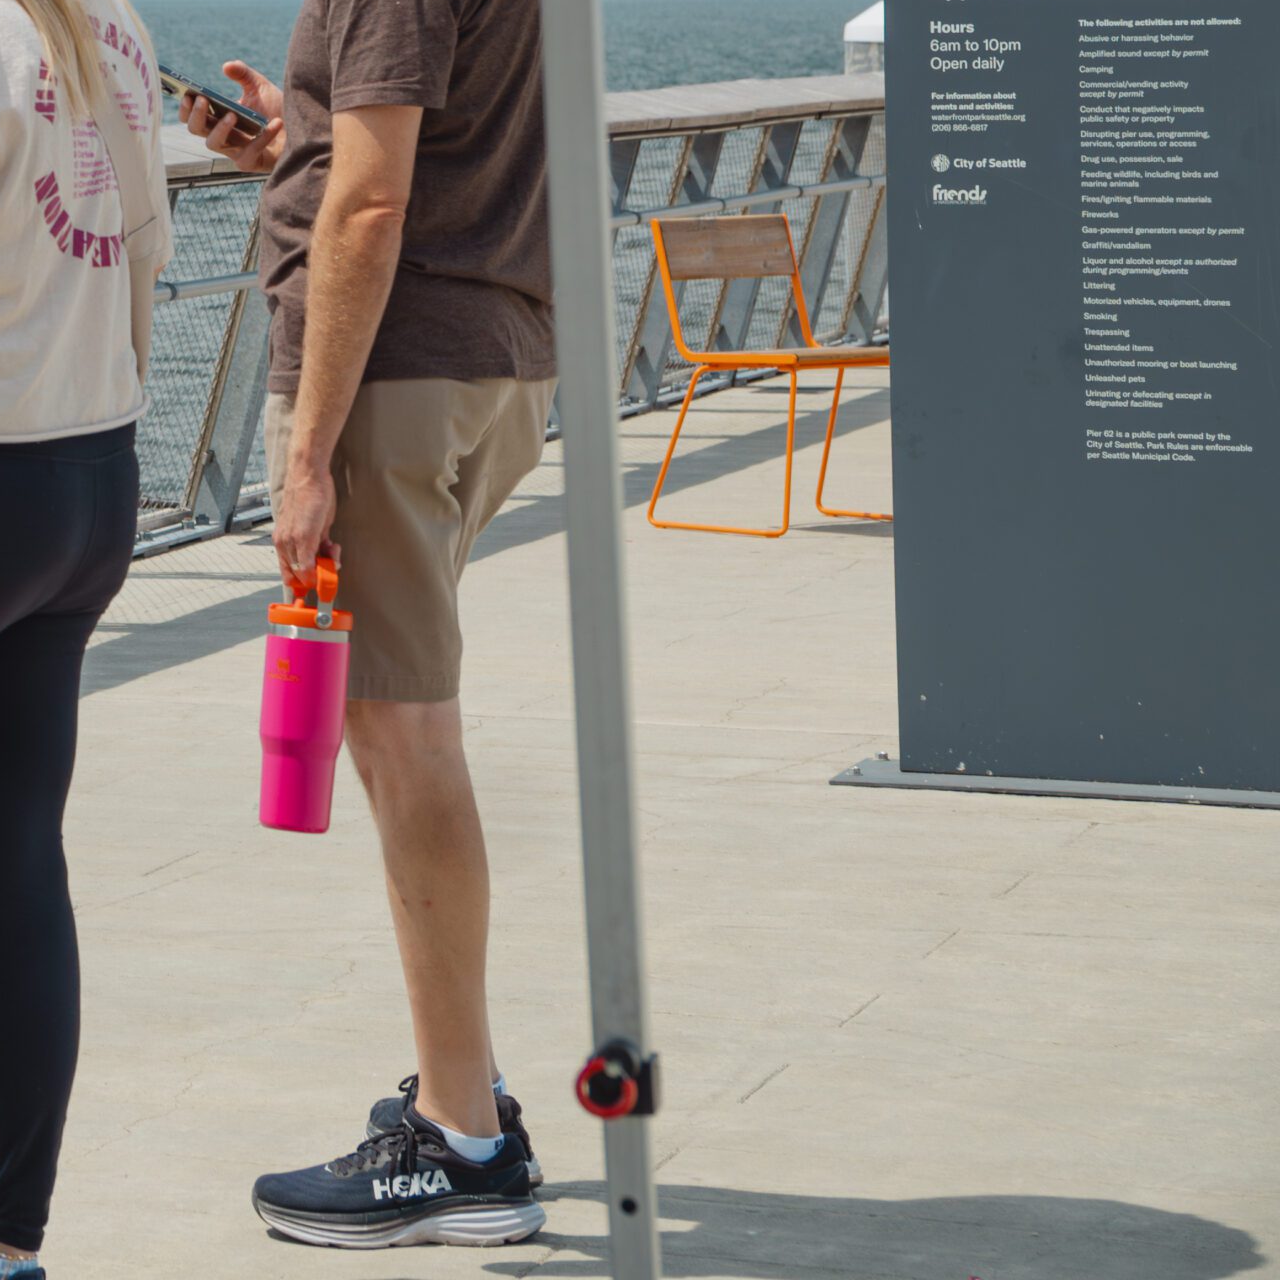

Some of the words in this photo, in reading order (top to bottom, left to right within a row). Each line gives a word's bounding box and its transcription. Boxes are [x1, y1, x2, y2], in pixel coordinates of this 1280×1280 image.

[930, 21, 974, 34] Hours
[1078, 19, 1094, 27] The
[1095, 19, 1134, 28] following
[1134, 18, 1174, 26] activities
[1190, 18, 1205, 26] not
[1206, 17, 1242, 26] allowed:
[1078, 34, 1110, 42] Abusive
[1121, 34, 1159, 44] harassing
[1160, 33, 1194, 42] behavior
[930, 39, 961, 52] 6am
[964, 40, 979, 52] to
[983, 39, 1021, 54] 10pm
[1078, 50, 1116, 59] Amplified
[1117, 50, 1142, 58] sound
[1143, 50, 1170, 58] except
[1171, 49, 1182, 58] by
[1182, 49, 1209, 58] permit
[930, 57, 968, 72] Open
[972, 56, 1004, 72] daily
[1079, 65, 1114, 74] Camping
[1079, 80, 1159, 90] Commercial/vending
[1160, 81, 1189, 89] activity
[931, 92, 945, 100] For
[946, 92, 992, 100] information
[993, 92, 1016, 100] about
[1079, 91, 1106, 99] except
[1107, 90, 1118, 99] by
[1118, 90, 1144, 99] permit
[931, 103, 958, 111] events
[958, 102, 974, 110] and
[975, 102, 1014, 110] activities:
[1079, 105, 1113, 114] Conduct
[1114, 105, 1131, 113] that
[1132, 105, 1172, 115] negatively
[1173, 106, 1204, 114] impacts
[1080, 115, 1104, 124] public
[1105, 115, 1130, 124] safety
[1141, 115, 1175, 124] property
[931, 124, 952, 132] (206)
[1080, 130, 1121, 140] Disrupting
[1121, 131, 1137, 139] pier
[1156, 130, 1210, 139] programming,
[1080, 140, 1115, 148] services,
[1115, 140, 1158, 149] operations
[953, 158, 974, 170] City
[976, 158, 987, 168] of
[988, 158, 1026, 168] Seattle
[1081, 155, 1100, 164] Drug
[1119, 155, 1165, 164] possession,
[1167, 155, 1183, 163] sale
[1081, 170, 1112, 180] Feeding
[1113, 170, 1143, 179] wildlife,
[1144, 171, 1180, 180] including
[1081, 180, 1108, 188] marine
[1109, 180, 1140, 188] animals
[933, 184, 987, 201] friends
[1081, 195, 1132, 205] Fires/igniting
[1133, 195, 1174, 203] flammable
[1175, 196, 1212, 204] materials
[1081, 210, 1119, 218] Fireworks
[1081, 226, 1134, 235] Gas-powered
[1135, 227, 1177, 236] generators
[1178, 227, 1206, 236] except
[1206, 227, 1217, 236] by
[1218, 227, 1245, 236] permit
[1082, 241, 1152, 250] Graffiti/vandalism
[1082, 257, 1107, 266] Liquor
[1108, 257, 1124, 265] and
[1125, 257, 1154, 265] alcohol
[1155, 258, 1182, 266] except
[1195, 258, 1238, 266] authorized
[1082, 266, 1108, 276] during
[1108, 267, 1189, 276] programming/events
[1083, 282, 1116, 291] Littering
[1083, 297, 1122, 305] Motorized
[1123, 297, 1157, 306] vehicles,
[1157, 299, 1202, 307] equipment,
[1203, 298, 1231, 307] drones
[1083, 312, 1118, 322] Smoking
[1084, 327, 1130, 338] Trespassing
[1084, 343, 1130, 352] Unattended
[1132, 344, 1154, 352] items
[1085, 359, 1136, 367] Unauthorized
[1137, 360, 1169, 370] mooring
[1179, 360, 1198, 369] boat
[1199, 361, 1238, 371] launching
[1085, 374, 1127, 382] Unleashed
[1128, 376, 1146, 384] pets
[1085, 390, 1121, 400] Urinating
[1132, 390, 1174, 401] defecating
[1175, 392, 1202, 401] except
[1085, 399, 1129, 409] designated
[1130, 400, 1163, 408] facilities
[1086, 429, 1102, 438] Pier
[1103, 430, 1114, 438] 62
[1131, 431, 1156, 440] public
[1157, 431, 1176, 441] park
[1177, 432, 1204, 440] owned
[1205, 433, 1216, 442] by
[1217, 433, 1231, 441] the
[1086, 440, 1103, 450] City
[1104, 440, 1113, 448] of
[1114, 441, 1145, 449] Seattle.
[1146, 442, 1165, 450] Park
[1166, 442, 1189, 451] Rules
[1205, 443, 1253, 452] enforceable
[1087, 452, 1100, 460] per
[1102, 451, 1130, 460] Seattle
[1132, 452, 1170, 462] Municipal
[1172, 453, 1195, 462] Code.
[372, 1169, 452, 1200] HOKA
